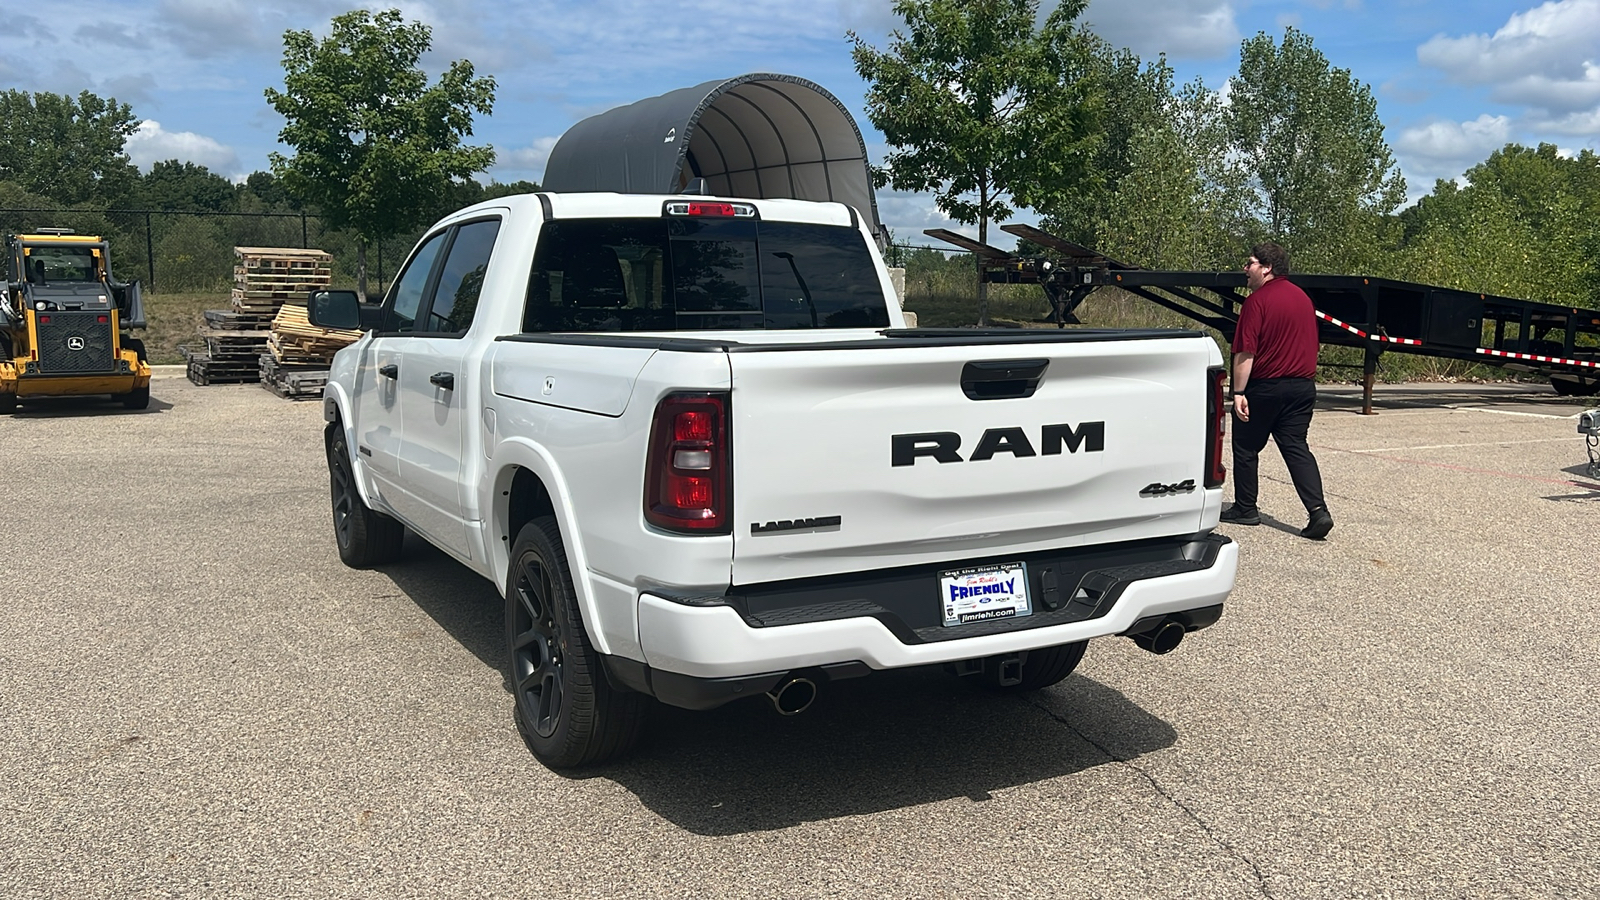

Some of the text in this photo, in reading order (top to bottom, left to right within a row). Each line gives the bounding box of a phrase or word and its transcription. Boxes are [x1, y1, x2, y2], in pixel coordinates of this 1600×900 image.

[891, 420, 1105, 467] RAM
[1139, 479, 1196, 497] 4x4
[950, 577, 1015, 602] FRIENDLY
[962, 609, 1014, 623] jimriehl.com
